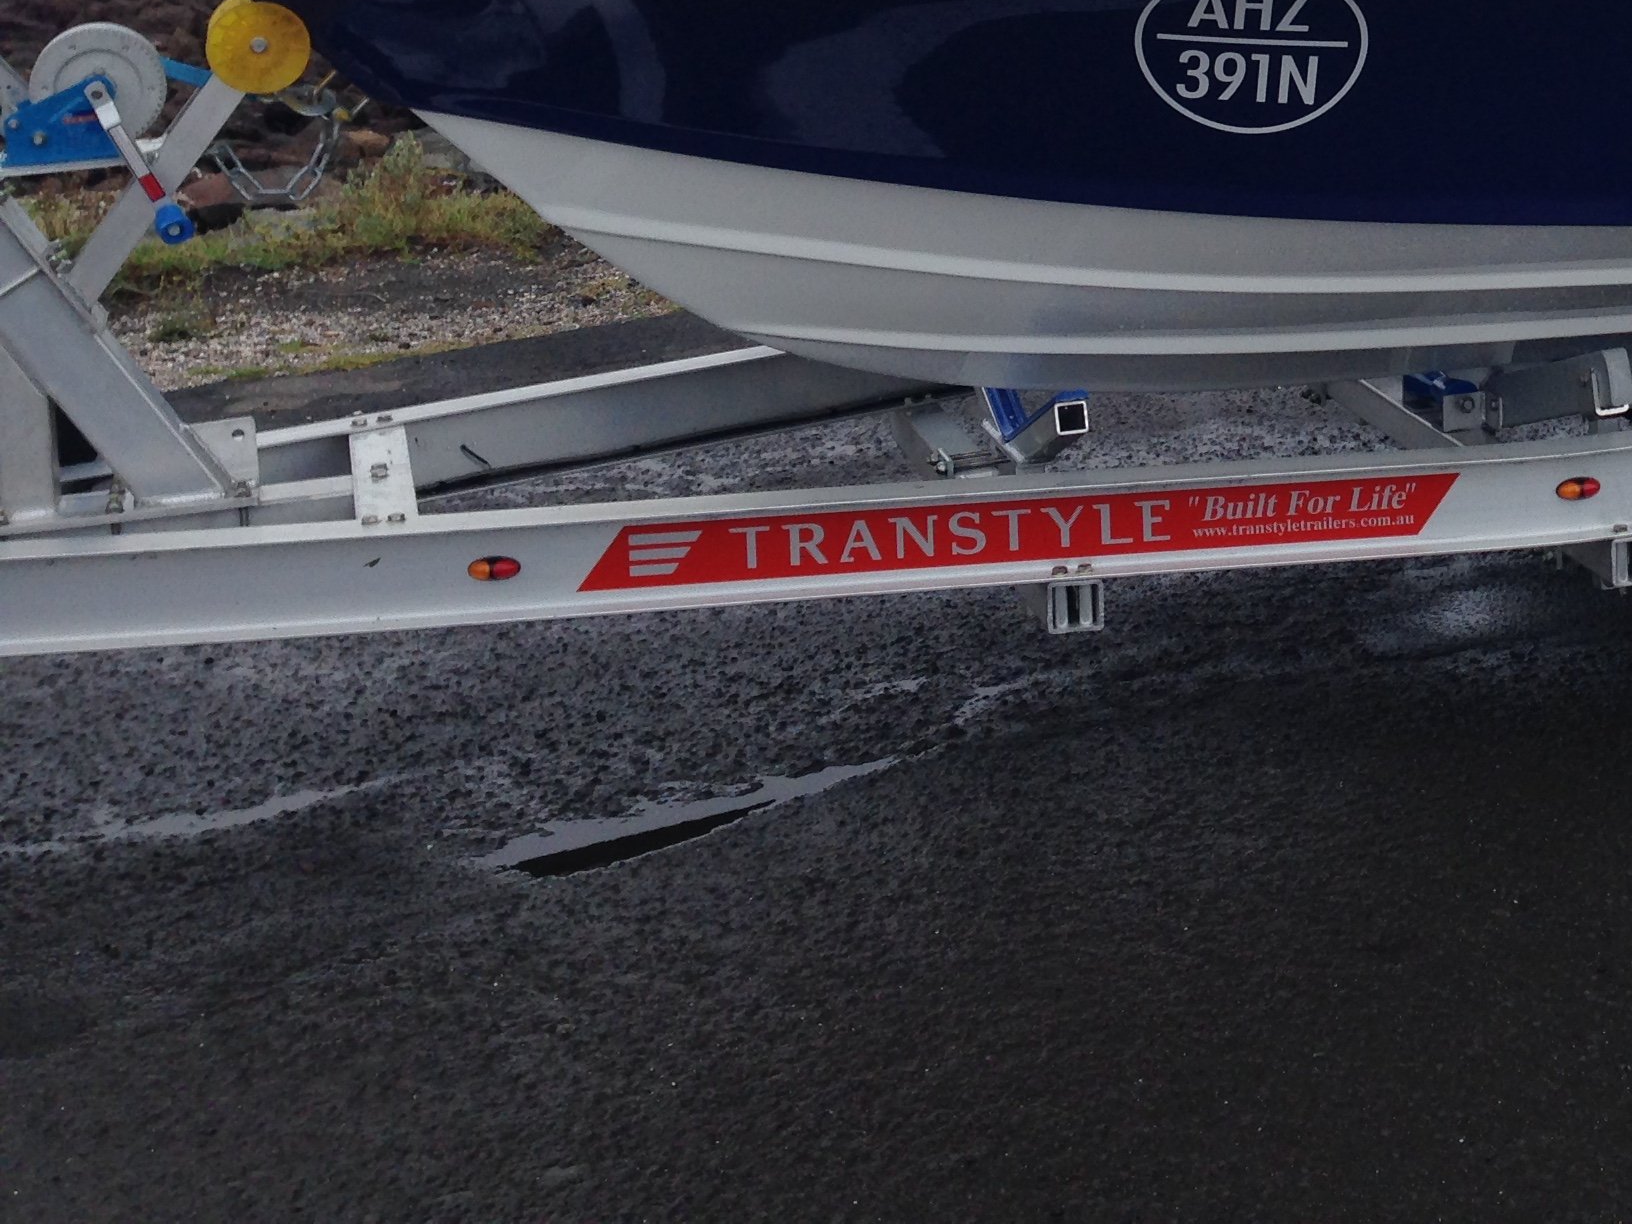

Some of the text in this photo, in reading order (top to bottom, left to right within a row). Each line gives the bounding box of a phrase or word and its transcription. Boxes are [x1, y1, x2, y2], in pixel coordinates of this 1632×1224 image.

[1176, 49, 1319, 105] 391N
[1188, 482, 1417, 522] "Built For Life"
[1192, 513, 1415, 538] www.transtyletrailers.com.au
[728, 499, 1171, 570] TRANSTYLE
